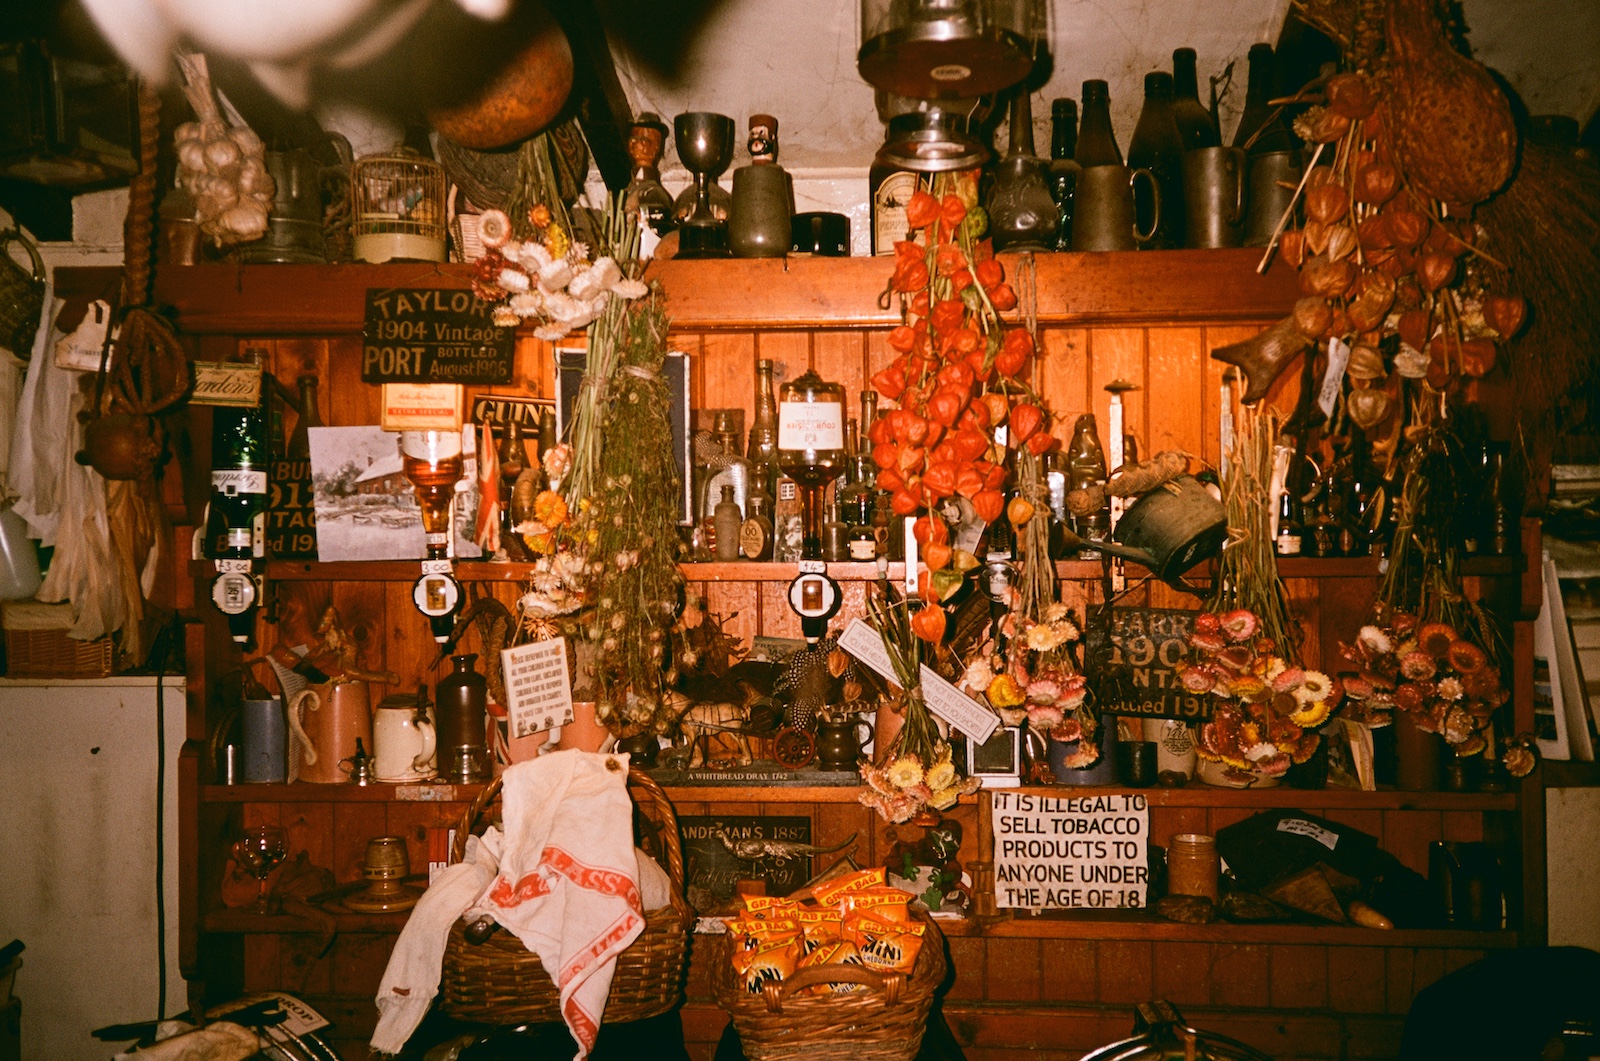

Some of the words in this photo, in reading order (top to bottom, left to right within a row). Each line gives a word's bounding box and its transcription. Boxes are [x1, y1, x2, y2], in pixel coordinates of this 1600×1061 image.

[377, 320, 428, 340] 1904
[434, 322, 504, 345] Vintage
[364, 346, 426, 376] PORT
[437, 347, 497, 358] BOTTLED
[195, 374, 254, 395] ordon's
[696, 772, 744, 780] WHITBREAD
[746, 772, 768, 780] DRAY
[994, 793, 1011, 810] IT
[1016, 794, 1034, 812] IS
[1039, 795, 1118, 813] ILLEGAL
[1121, 794, 1146, 811] TO
[773, 827, 807, 840] 1887
[1000, 816, 1046, 834] SELL
[1051, 817, 1140, 835] TOBACCO
[1003, 841, 1107, 859] PRODUCTS
[1112, 841, 1138, 859] TO
[854, 874, 877, 890] BAG
[997, 864, 1074, 882] ANYONE
[1081, 865, 1148, 884] UNDER
[1005, 888, 1041, 906] THE
[1045, 889, 1082, 907] AGE
[1087, 889, 1113, 907] OF
[1118, 890, 1140, 907] 18
[860, 940, 902, 960] MINI
